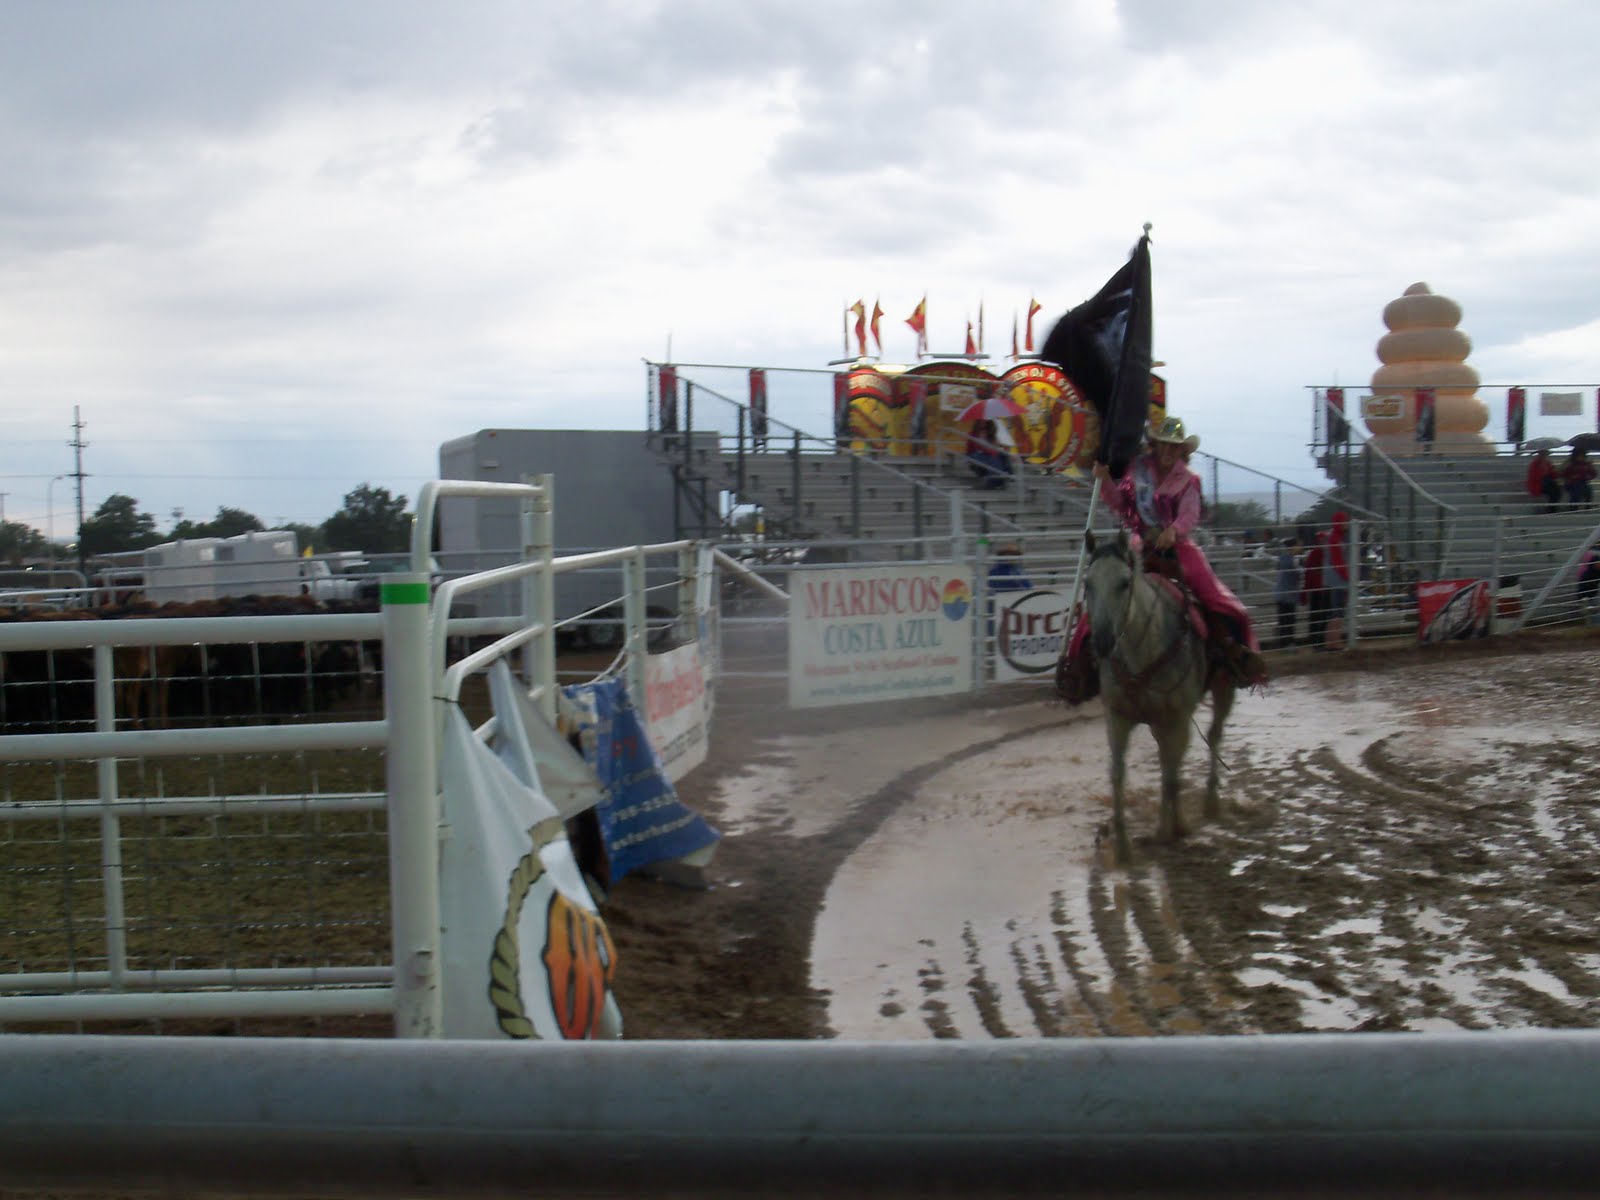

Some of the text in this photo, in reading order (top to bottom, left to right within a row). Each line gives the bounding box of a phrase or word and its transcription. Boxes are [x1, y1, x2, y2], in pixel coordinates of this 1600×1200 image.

[804, 575, 941, 619] MARISCOS
[823, 618, 943, 655] COSTA AZUL
